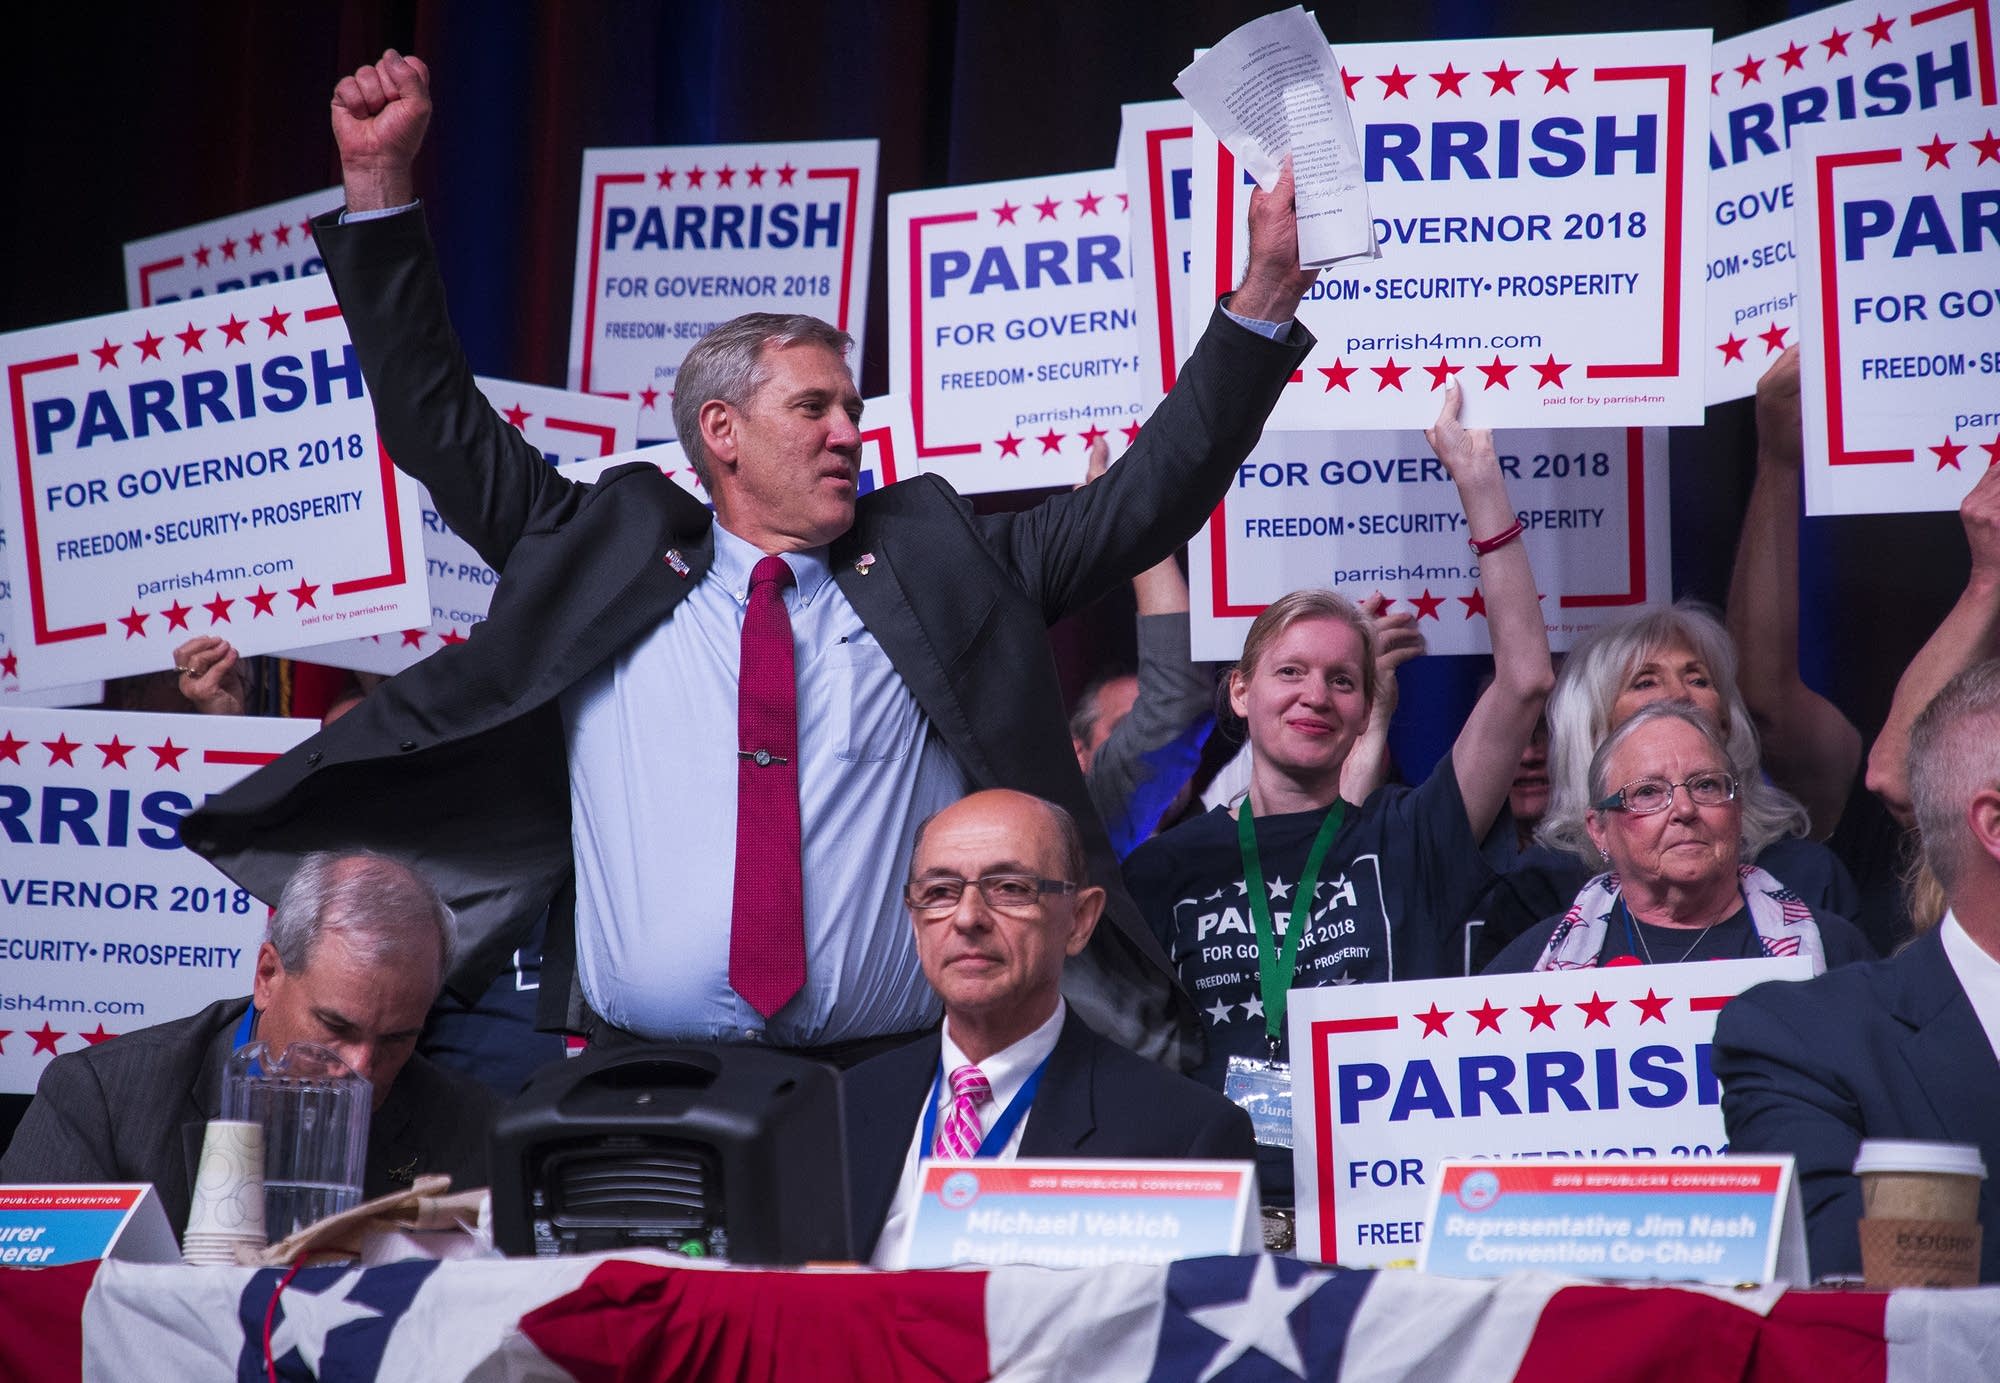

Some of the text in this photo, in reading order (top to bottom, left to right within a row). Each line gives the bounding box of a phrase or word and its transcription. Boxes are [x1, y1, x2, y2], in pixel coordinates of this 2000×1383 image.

[1709, 41, 1972, 170] RRISH
[1364, 115, 1657, 182] RRISH
[1716, 183, 1793, 225] GOVE
[606, 203, 840, 250] PARRISH
[1374, 212, 1646, 245] OVERNOR 2018
[931, 235, 1124, 298] PARR
[606, 276, 829, 297] FOR GOVERNOR 2018
[1375, 277, 1484, 300] SECURITY
[1499, 274, 1638, 296] PROSPERITY
[1735, 293, 1797, 328] parrish
[1855, 295, 1927, 324] FOR
[604, 322, 717, 340] FREEDOM SECUR
[937, 309, 1136, 346] FOR GOVERN
[1348, 334, 1541, 354] parrish4mn.com
[941, 368, 1025, 390] FREEDOM
[1036, 357, 1122, 382] SECURITY
[1860, 353, 1965, 380] FREEDOM
[32, 344, 364, 455] PARRISH
[1015, 402, 1143, 428] parrish4mn.c
[1543, 394, 1665, 406] paid for by parrish4mn
[47, 434, 363, 511] FOR GOVERNOR 2018
[1238, 453, 1609, 488] FOR GOVERR 2018
[56, 490, 363, 562] FREEDOM SECURITY PROSPERITY
[1246, 508, 1605, 538] FREEDOM SECURITY SPERITY
[138, 559, 293, 599] parrish4mn.com
[1334, 564, 1481, 586] parrish4mn.c
[323, 612, 334, 622] for
[349, 602, 398, 618] parrish4mn
[0, 784, 193, 850] RRIS
[1, 879, 250, 914] VERNOR 2018
[0, 938, 241, 968] ECURITY PROSPERITY
[1203, 945, 1233, 963] FOR
[1318, 919, 1356, 943] 2018
[1195, 972, 1241, 991] FREEDOM
[1314, 947, 1370, 971] PROSPERITY
[0, 992, 145, 1016] ish4mn.com
[1338, 1044, 1718, 1124] PARRIS
[1350, 1159, 1425, 1188] FOR
[55, 1197, 121, 1205] CONVENTION
[967, 1210, 1180, 1240] Michael Vekich
[1356, 1220, 1425, 1246] FREED
[1445, 1213, 1757, 1242] Representative Jim Nash
[1465, 1239, 1726, 1264] Convention Co-Chair
